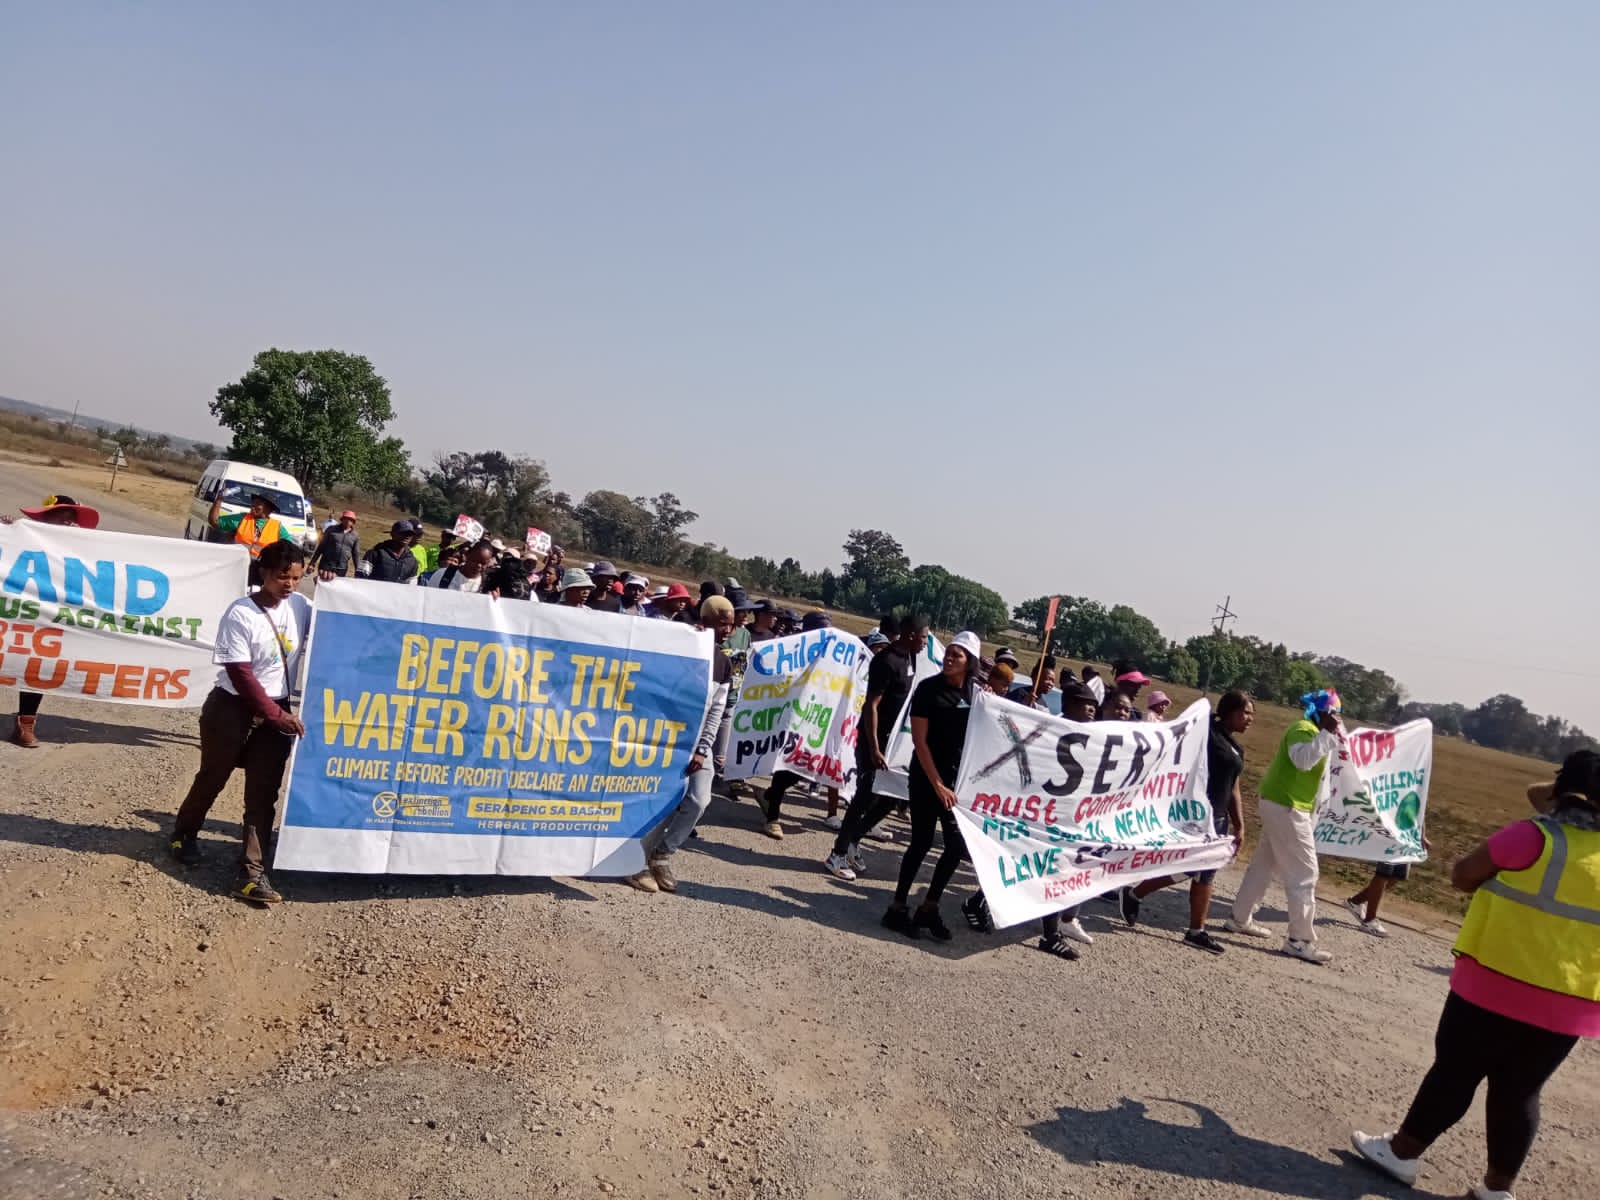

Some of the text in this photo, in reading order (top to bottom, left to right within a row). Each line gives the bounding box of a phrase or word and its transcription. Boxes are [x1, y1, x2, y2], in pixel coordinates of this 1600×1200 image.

[0, 548, 170, 615] AND
[52, 607, 202, 641] AGAINST
[397, 633, 641, 712] BEFORE THE
[752, 629, 856, 676] Children
[743, 675, 792, 700] and
[323, 687, 686, 768] WATER RUNS OUT
[325, 756, 663, 794] CLIMATE BEFORE PROFIT DECLARE AN EMERGENCY
[1371, 768, 1426, 794] KILLING
[474, 801, 617, 818] SERAPENG SA BASADI
[971, 771, 1188, 826] must COMPL WITH
[477, 821, 609, 833] HERBAL PRODUCTION
[1114, 804, 1163, 840] NEMA
[1167, 798, 1207, 823] AND
